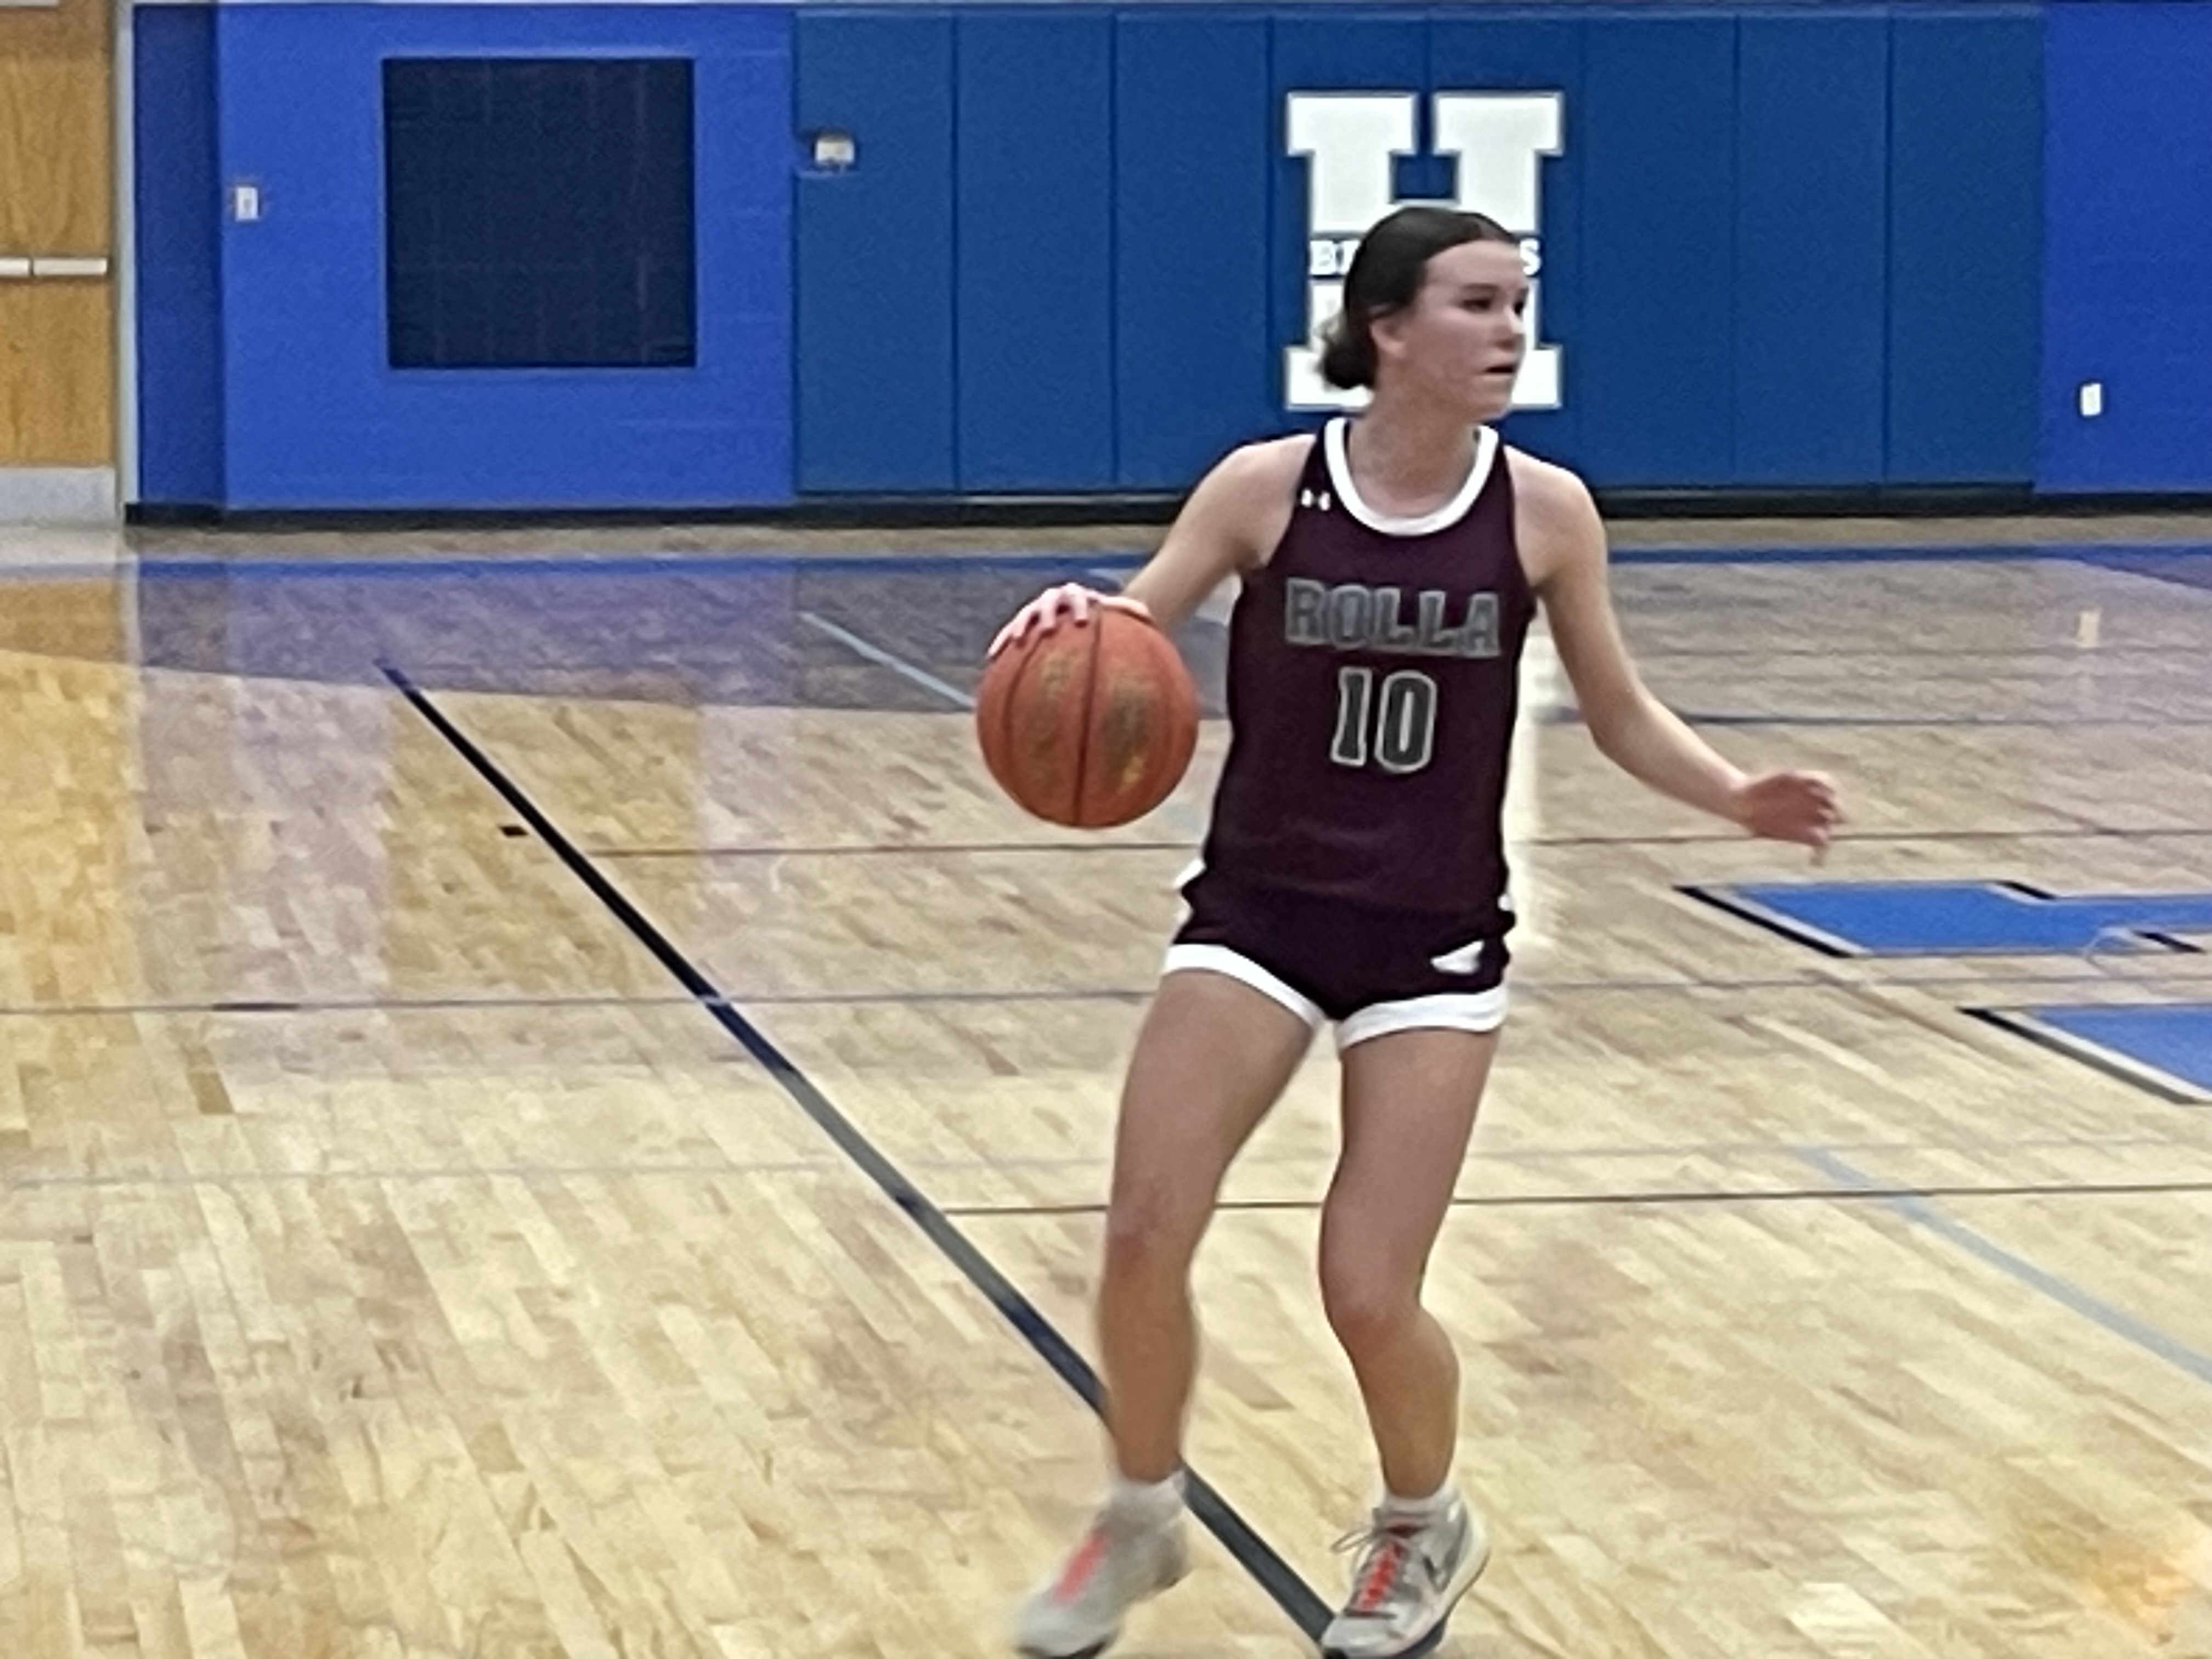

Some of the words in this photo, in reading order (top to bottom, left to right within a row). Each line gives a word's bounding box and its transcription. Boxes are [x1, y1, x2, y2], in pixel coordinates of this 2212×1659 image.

[1286, 92, 1564, 410] H
[1285, 577, 1500, 657] ROLLA
[1330, 667, 1437, 772] 10
